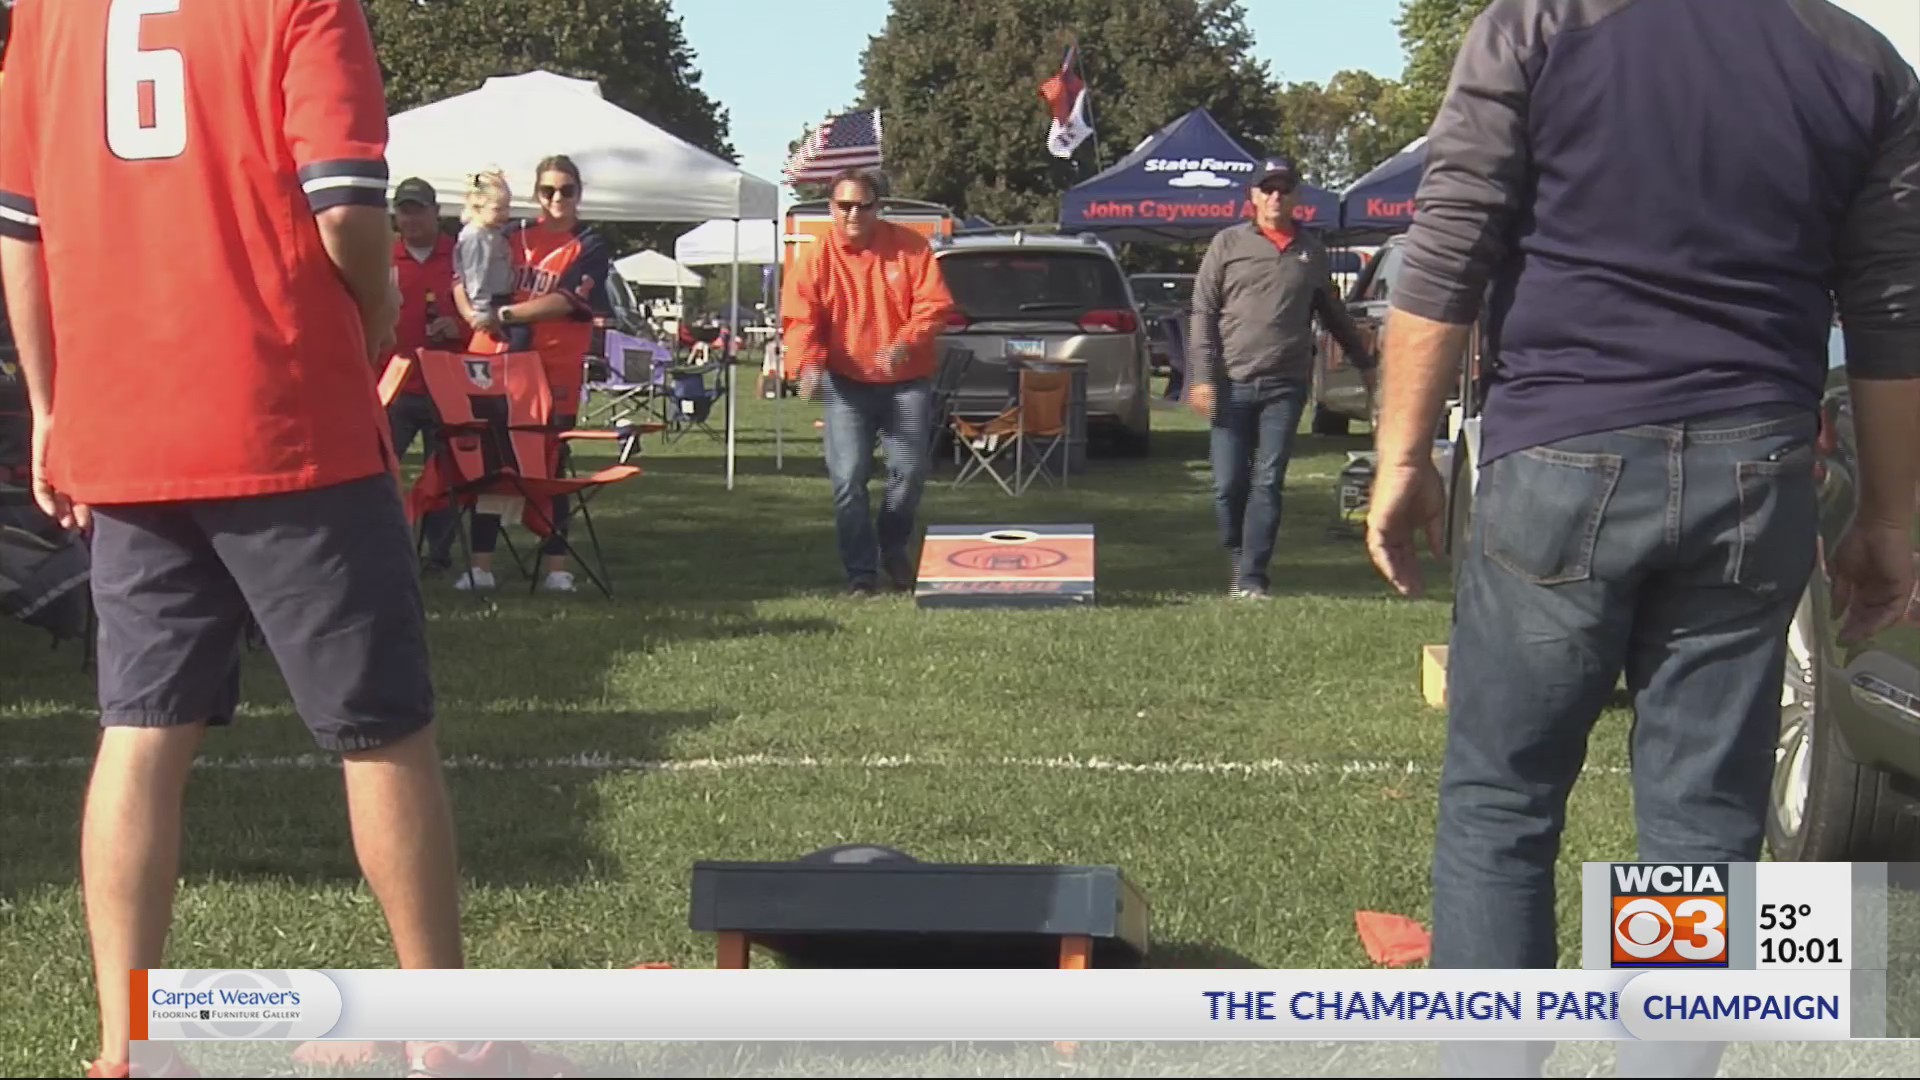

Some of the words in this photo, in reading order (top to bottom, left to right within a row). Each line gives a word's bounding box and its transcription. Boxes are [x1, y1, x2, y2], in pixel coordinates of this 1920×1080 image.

[104, 0, 188, 161] 6
[1083, 201, 1134, 218] John
[1138, 200, 1236, 221] Caywood
[1239, 200, 1317, 221] Acy
[1366, 198, 1417, 217] Kurt
